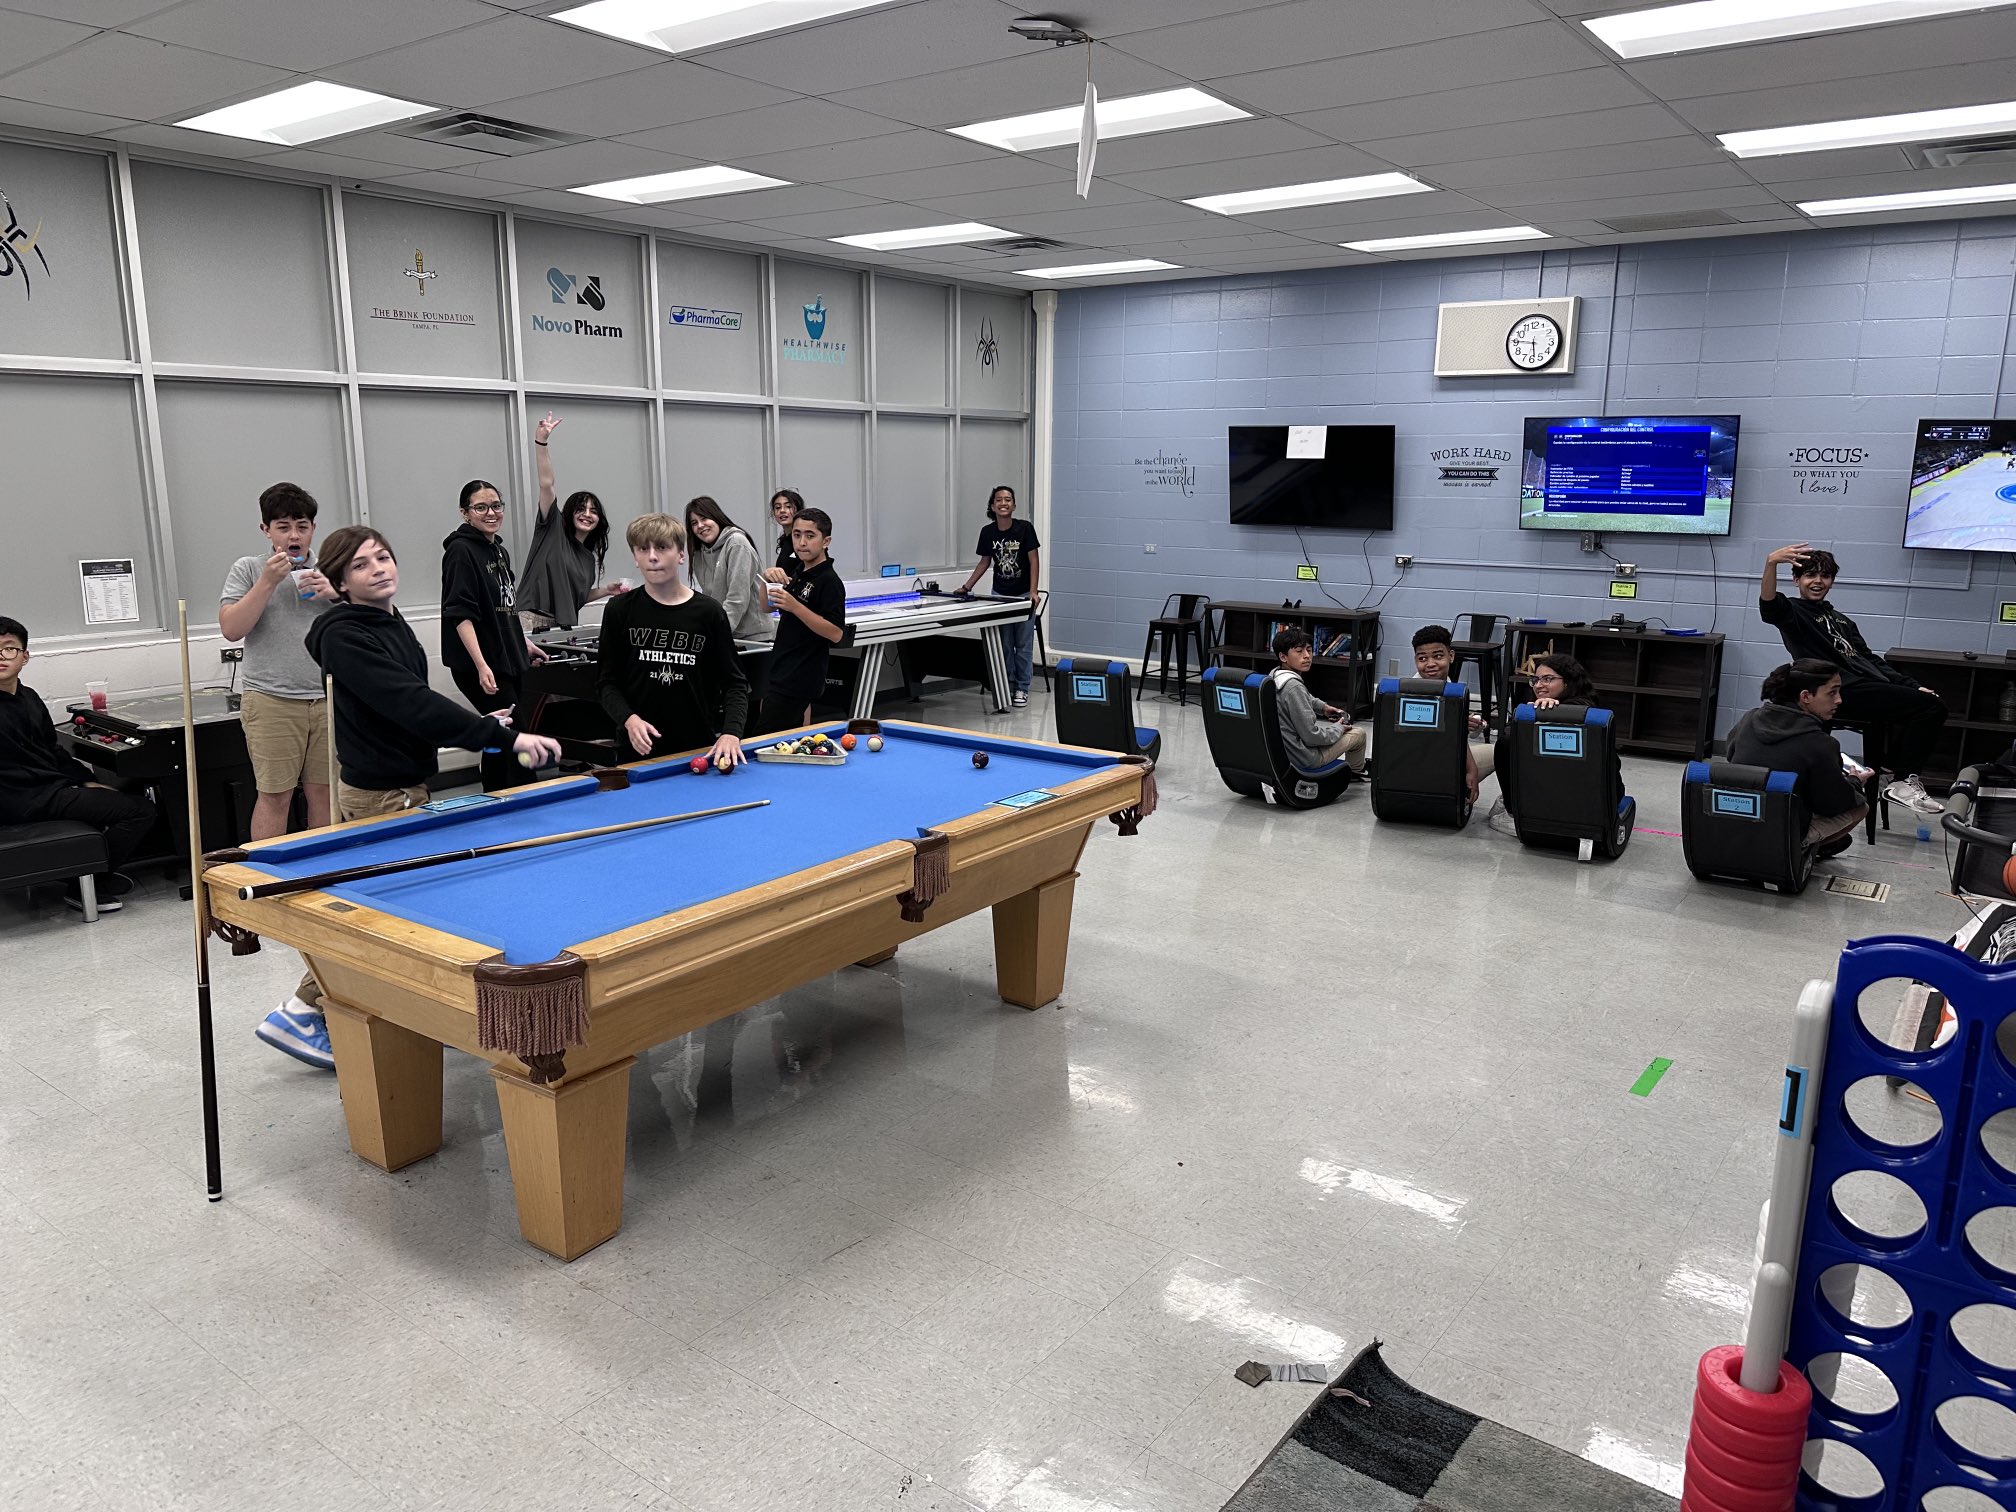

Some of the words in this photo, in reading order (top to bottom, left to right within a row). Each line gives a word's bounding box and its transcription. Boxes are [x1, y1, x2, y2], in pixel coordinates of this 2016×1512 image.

[373, 307, 390, 317] THE
[393, 309, 418, 319] BRINK
[422, 311, 474, 322] FOUNDATION
[686, 311, 738, 327] PharmaCore
[1531, 321, 1540, 330] 12
[1516, 330, 1525, 339] 10
[1546, 329, 1552, 337] 2
[783, 338, 847, 351] HEALTHWISE
[1549, 338, 1555, 346] 3
[1515, 347, 1521, 355] 8
[1545, 347, 1551, 355] 4
[1522, 354, 1528, 362] 7
[1538, 353, 1544, 361] 5
[1430, 447, 1470, 461] WORK
[1473, 447, 1512, 462] HARD
[1794, 448, 1863, 463] FOCUS
[1793, 470, 1807, 478] DO
[1809, 470, 1837, 478] WHAT
[1840, 470, 1860, 478] YOU
[628, 627, 706, 652] WEBB
[638, 649, 697, 666] ATHLETICS
[649, 671, 658, 679] 21
[674, 673, 684, 681] 22
[1408, 705, 1431, 713] Station
[1722, 796, 1751, 805] Station
